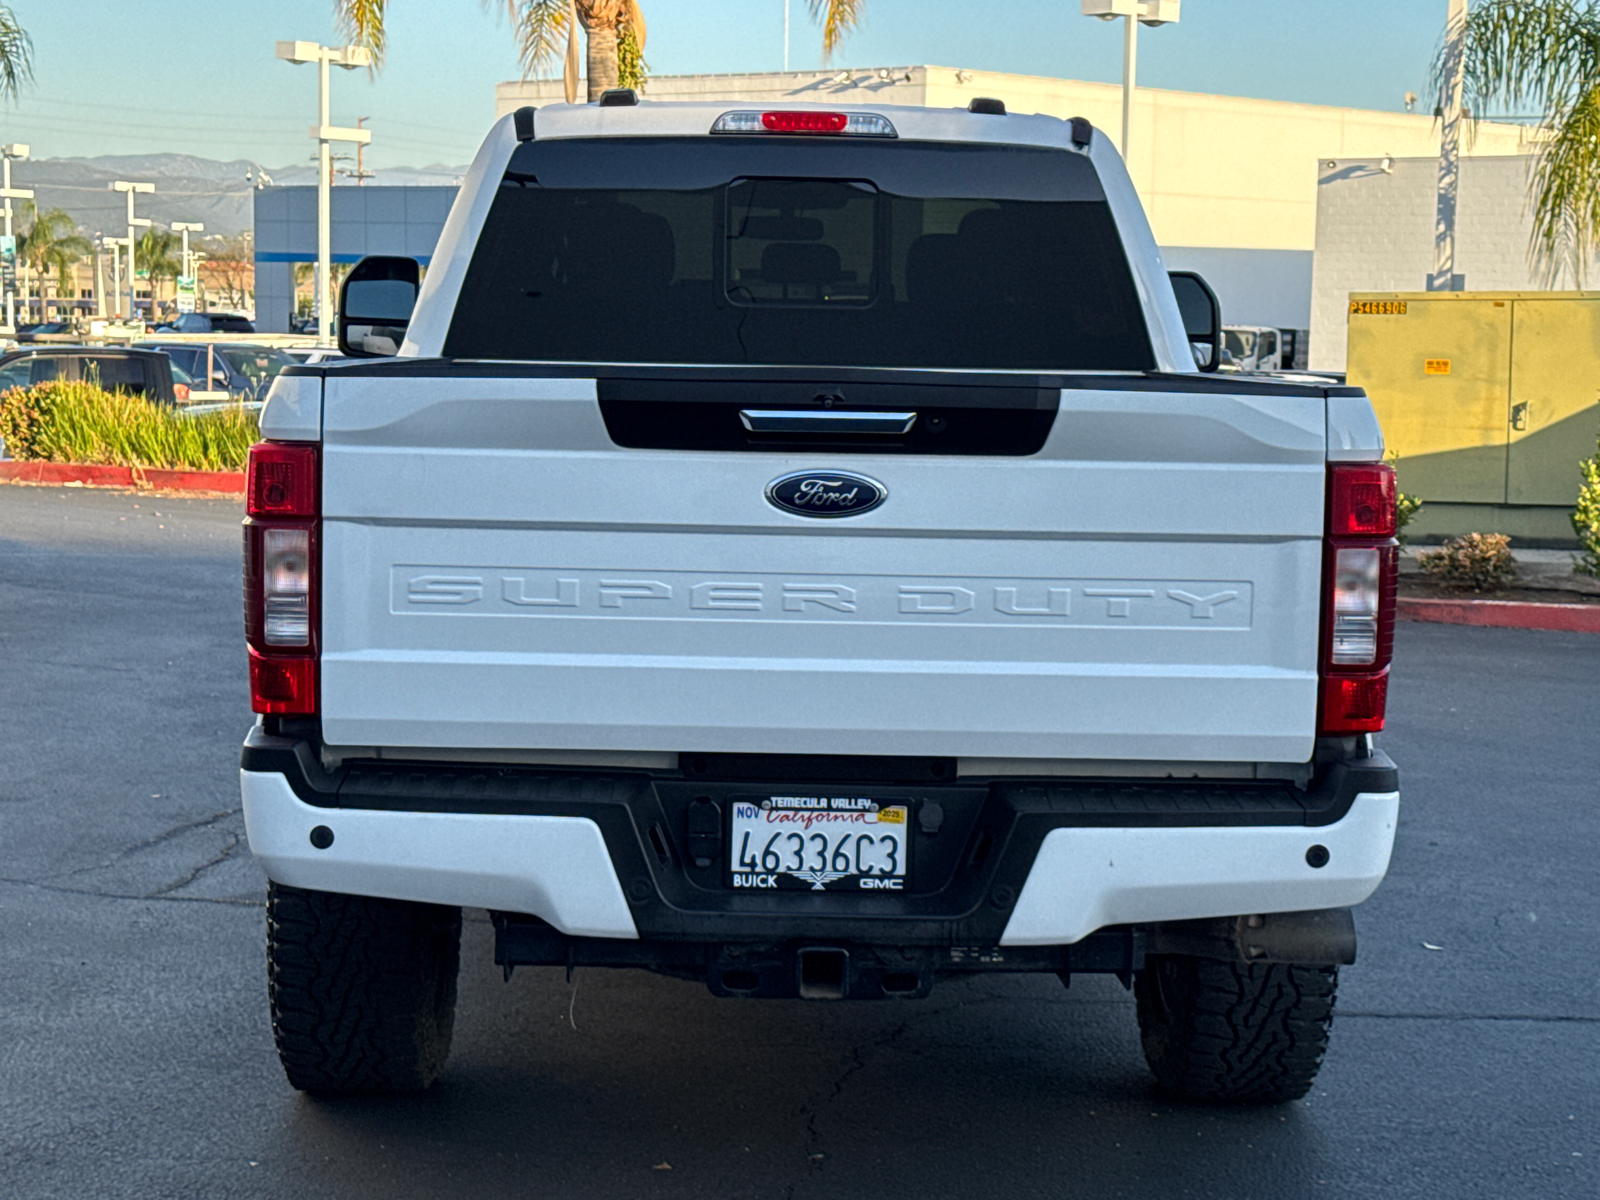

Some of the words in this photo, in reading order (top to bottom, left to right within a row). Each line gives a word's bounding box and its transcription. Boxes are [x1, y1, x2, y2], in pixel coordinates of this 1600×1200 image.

[1350, 302, 1406, 313] P5466906
[794, 479, 858, 506] Ford
[408, 575, 856, 612] SUPER
[898, 585, 1238, 619] DUTY
[771, 796, 827, 808] TEMECULA
[831, 798, 871, 809] VALLEY
[737, 806, 759, 818] NOV
[766, 809, 879, 830] California
[739, 830, 898, 875] 46336C3
[733, 874, 777, 887] BUICK
[860, 878, 903, 889] GMC
